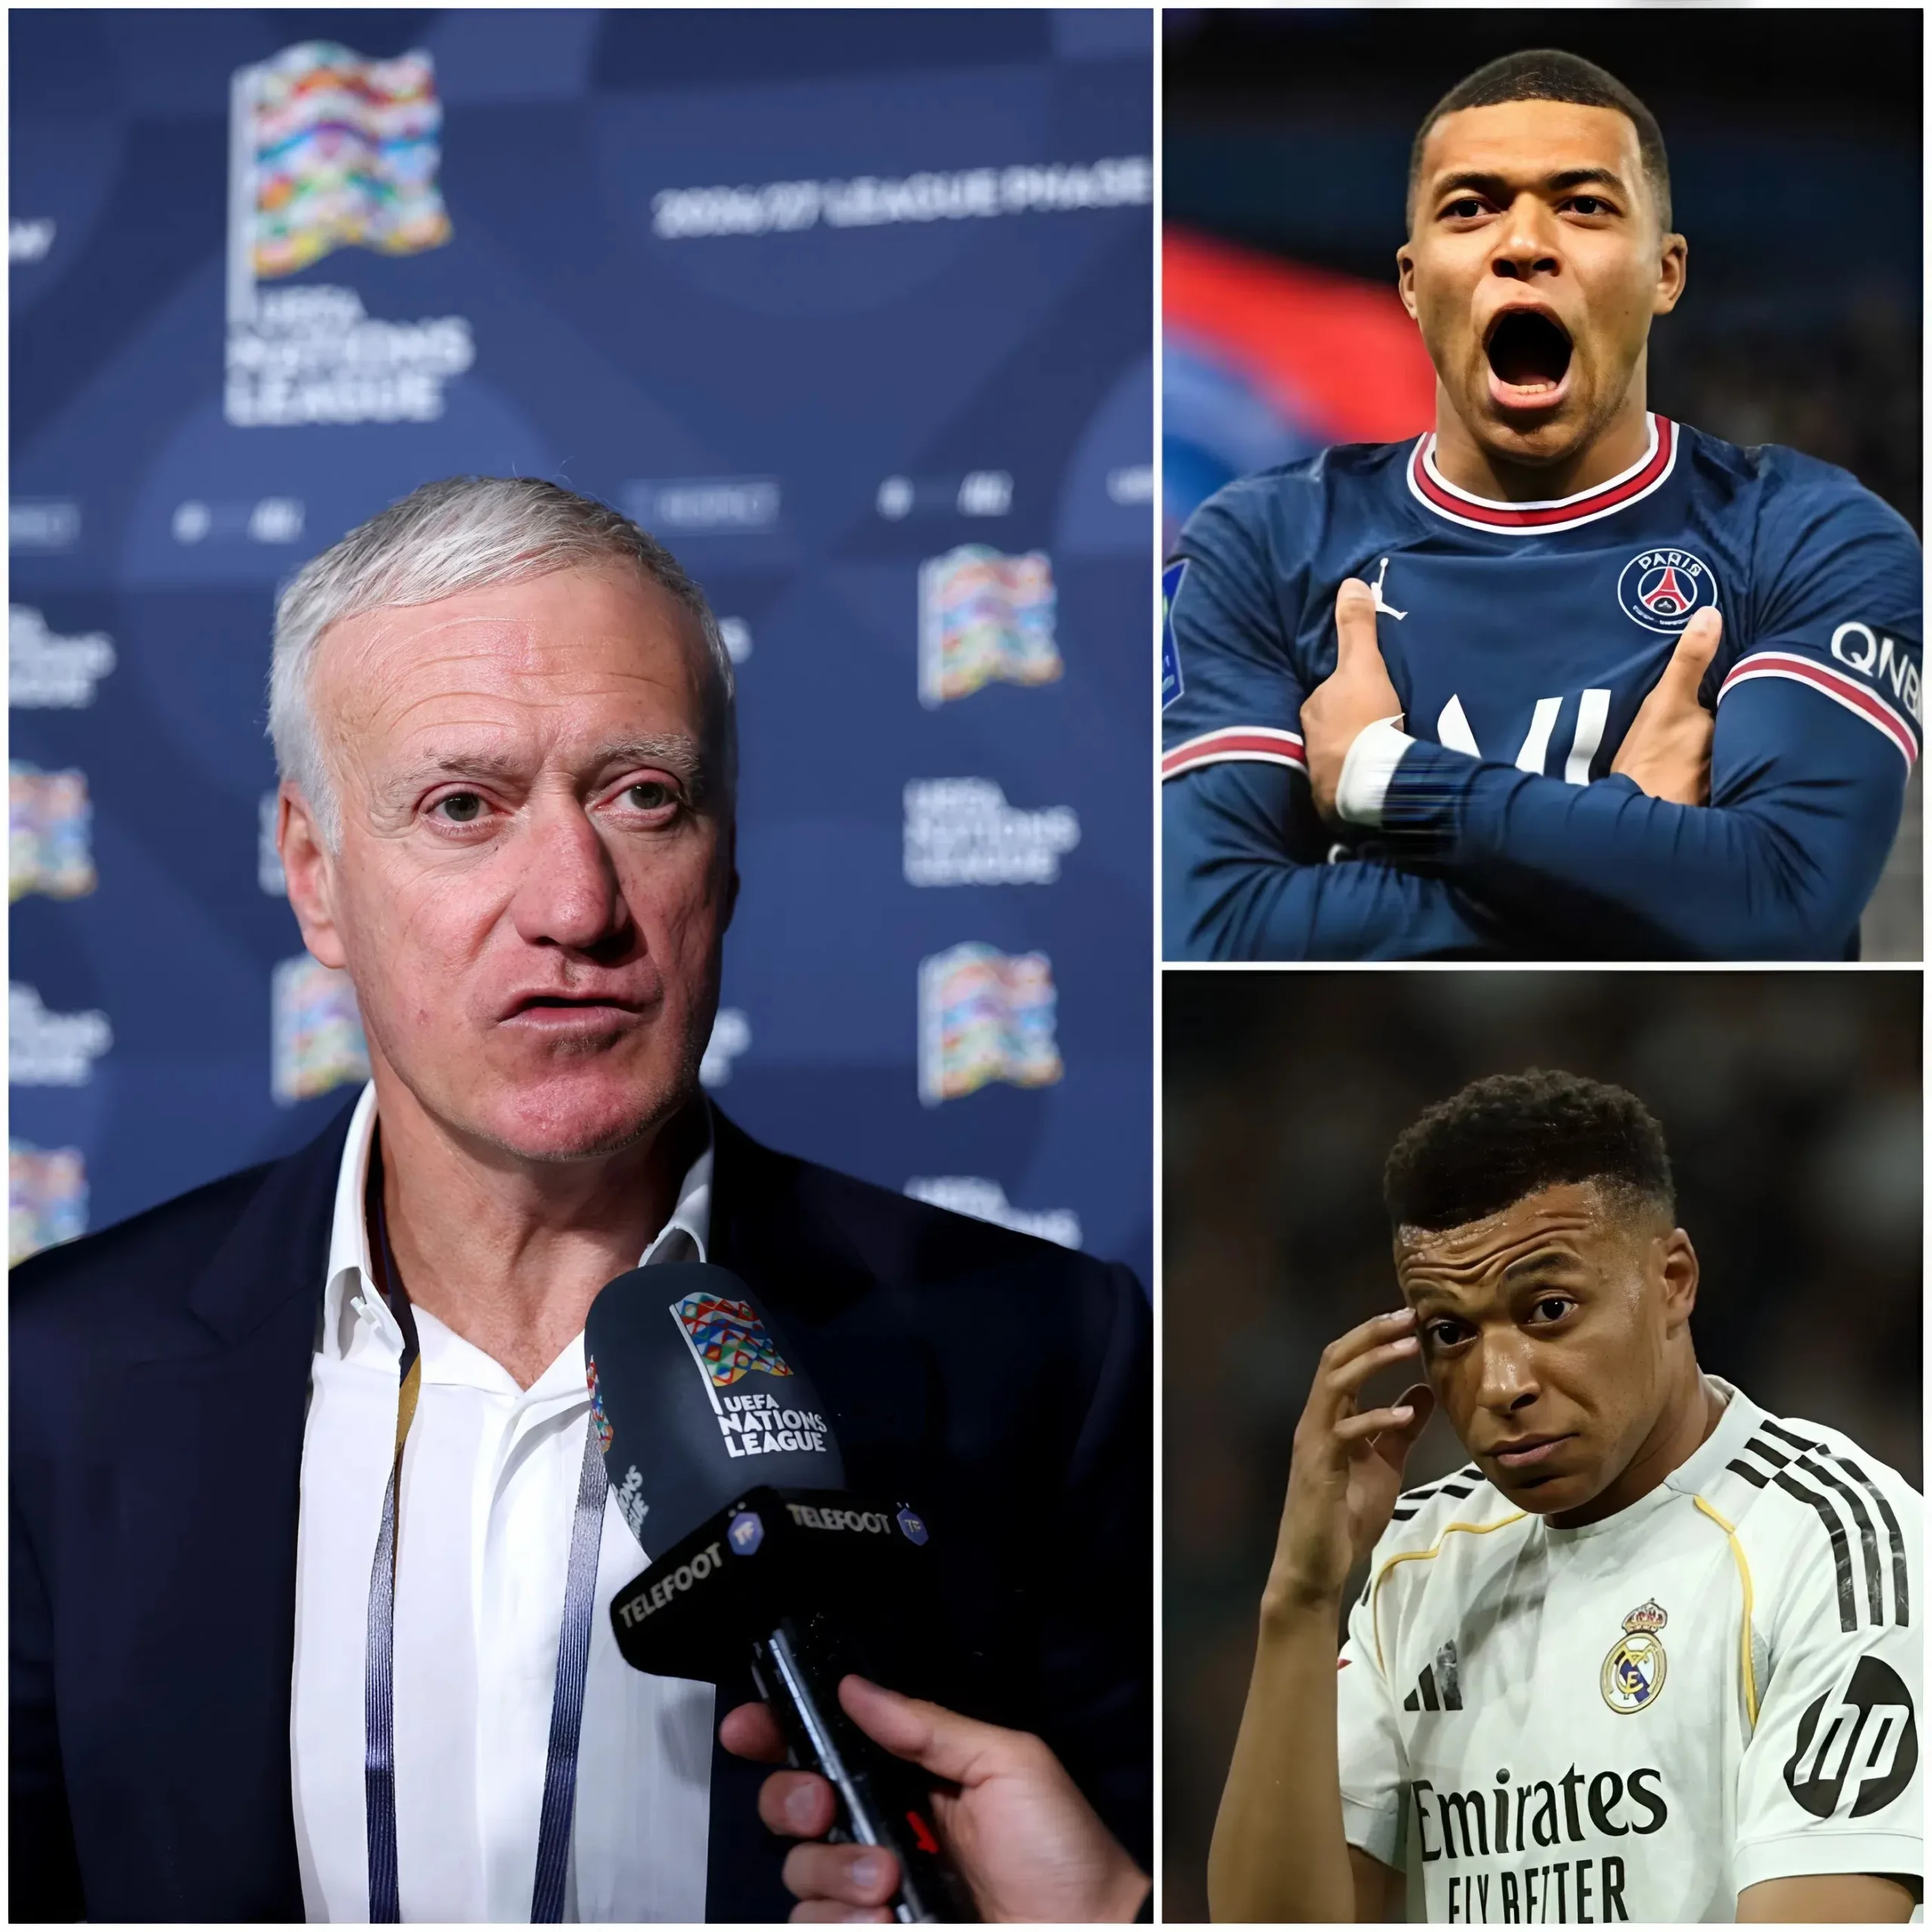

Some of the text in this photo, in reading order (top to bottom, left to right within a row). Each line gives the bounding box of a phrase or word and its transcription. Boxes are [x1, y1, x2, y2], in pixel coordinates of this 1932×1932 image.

[821, 168, 999, 226] LEAGUE
[717, 1409, 827, 1436] NATIONS
[723, 1394, 780, 1413] UEFA
[724, 1430, 827, 1458] LEAGUE
[785, 1503, 891, 1534] TELEFOOT
[619, 1541, 723, 1628] TELEFOOT
[1792, 1654, 1910, 1819] hp
[1411, 1761, 1668, 1863] Emirates
